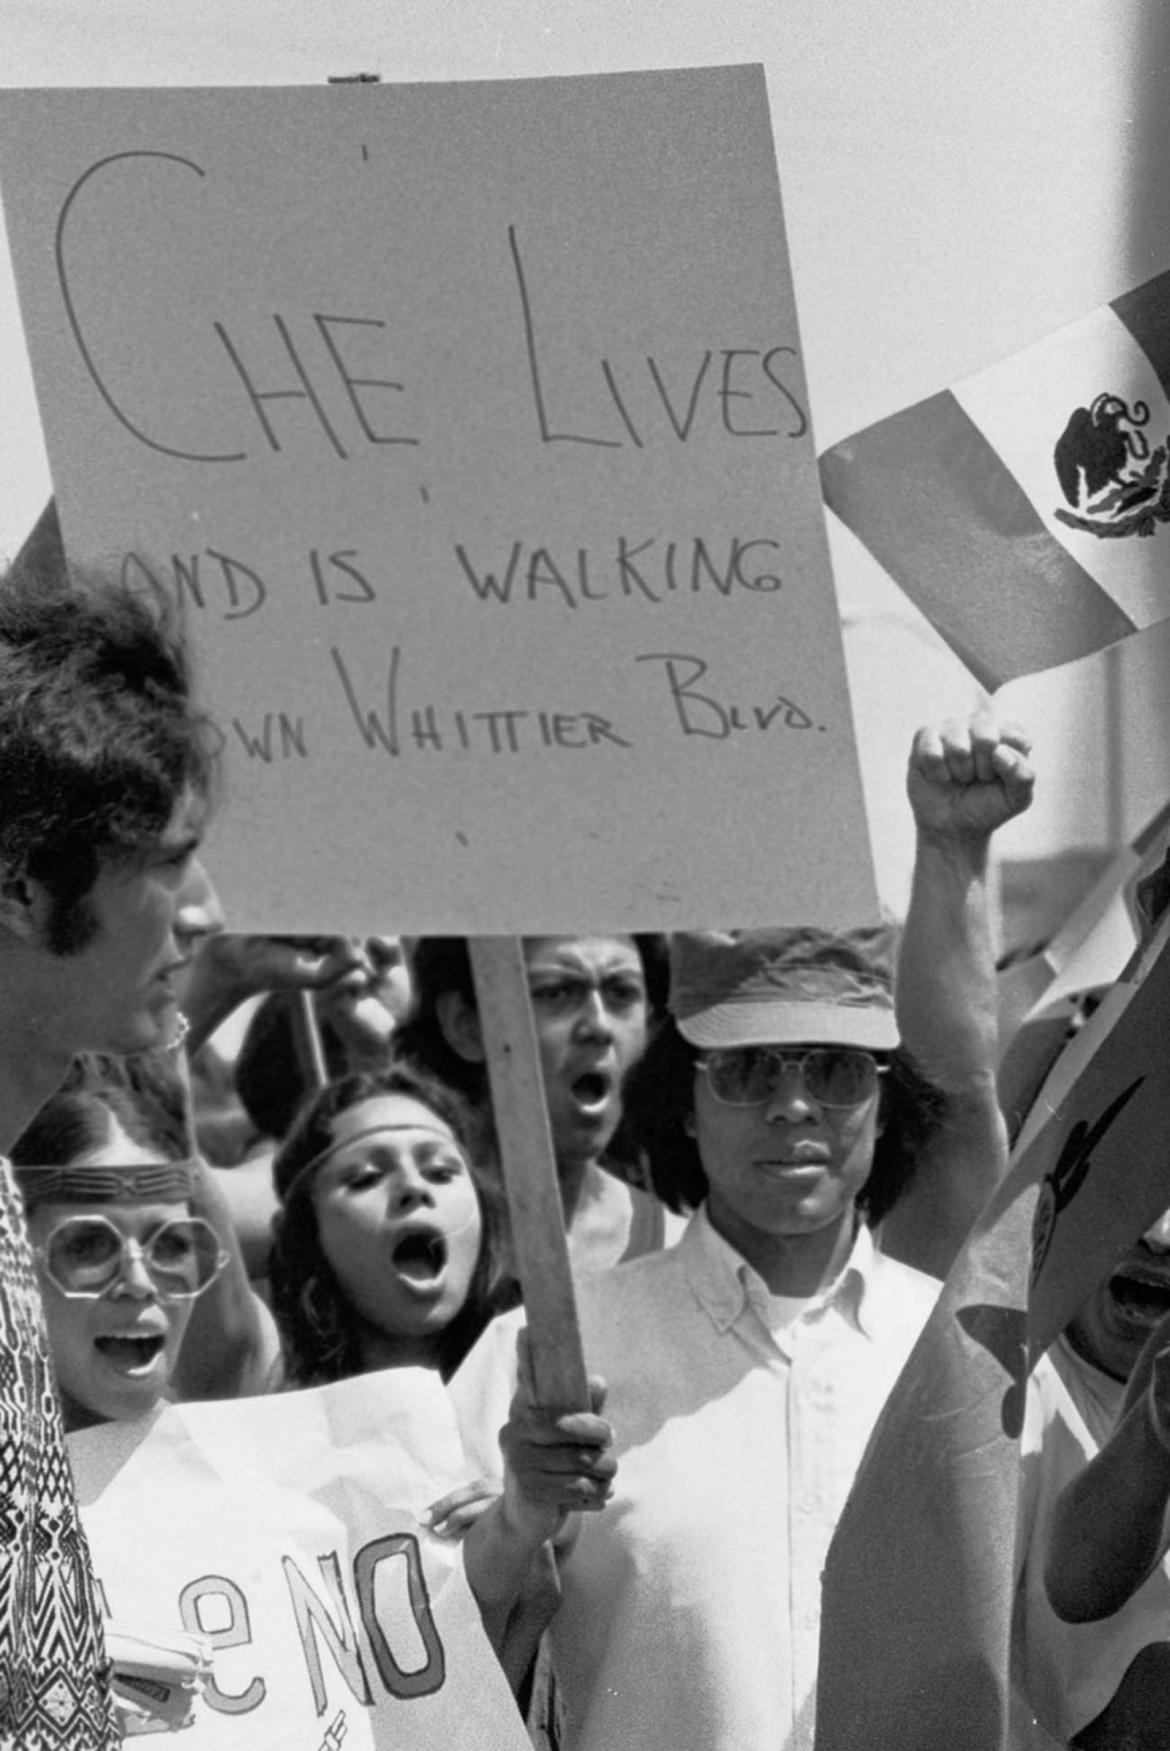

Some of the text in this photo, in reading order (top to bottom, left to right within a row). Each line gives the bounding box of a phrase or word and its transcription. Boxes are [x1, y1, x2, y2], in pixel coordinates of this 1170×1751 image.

[56, 150, 807, 461] CHE LIVES
[119, 536, 783, 620] AND IS WALKING
[190, 713, 309, 764] OWN
[331, 645, 634, 758] WHITTIER
